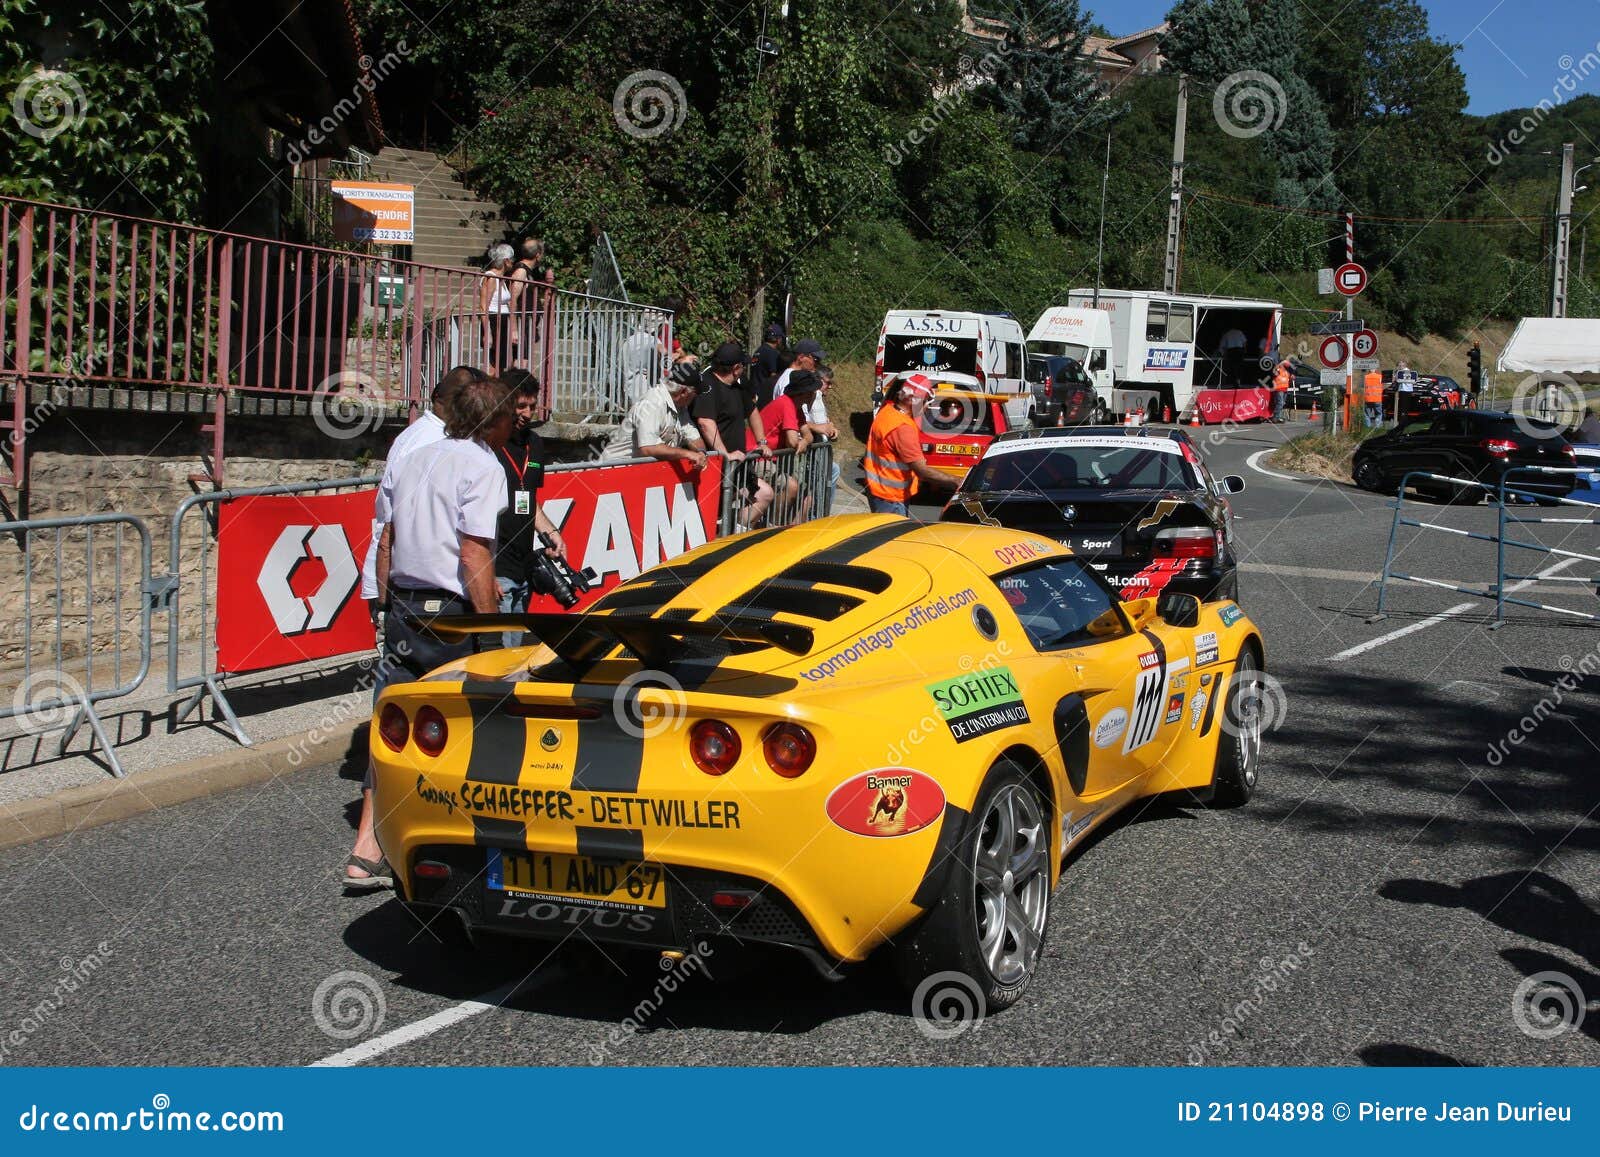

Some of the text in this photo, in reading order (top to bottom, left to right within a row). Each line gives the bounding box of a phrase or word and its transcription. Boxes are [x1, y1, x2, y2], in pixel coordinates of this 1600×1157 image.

[367, 191, 413, 200] TRANSACTION
[379, 230, 389, 239] 32
[391, 231, 401, 240] 32
[403, 231, 413, 241] 32
[903, 318, 962, 333] A.S.S.U
[1050, 316, 1083, 326] PODIUM
[903, 338, 937, 351] AMBULANCE
[1082, 540, 1113, 550] Sport
[994, 543, 1037, 565] OPEN
[799, 588, 978, 682] topmontagne-officiel.com
[932, 672, 1019, 713] SOFITEX
[1129, 672, 1164, 750] 111
[951, 724, 968, 739] DE
[867, 775, 912, 790] Banner
[459, 782, 575, 821] SCHAEFFER
[591, 796, 741, 829] DETTWILLER
[508, 855, 661, 901] 111 AWD 67
[497, 899, 656, 932] LOTUS
